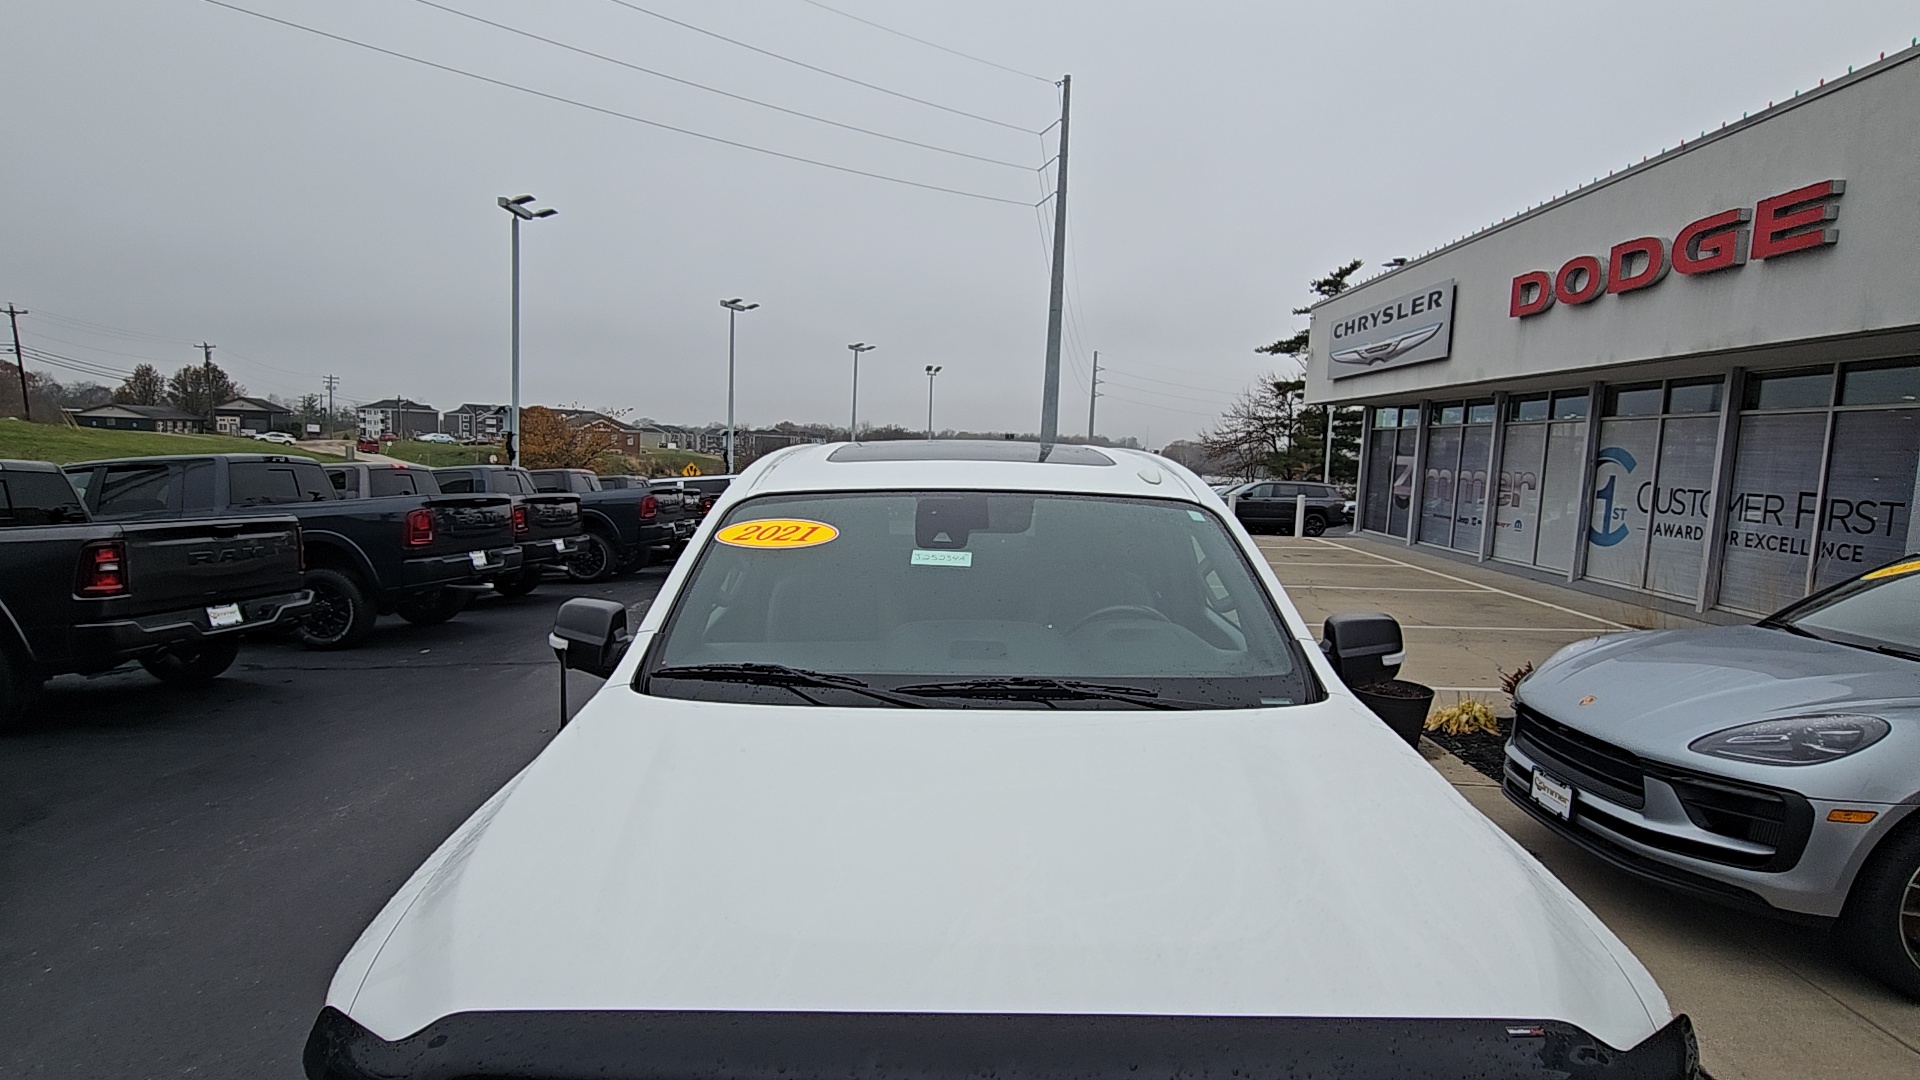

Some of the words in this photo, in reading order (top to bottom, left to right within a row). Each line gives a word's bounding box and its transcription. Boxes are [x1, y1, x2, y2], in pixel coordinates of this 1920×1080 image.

[1509, 179, 1846, 319] DODGE
[1333, 290, 1443, 339] CHRYSLER
[1389, 454, 1537, 509] Zmmer
[731, 525, 822, 542] 2021
[1794, 491, 1907, 537] FIRST
[188, 546, 264, 565] RAM
[1653, 522, 1704, 541] AWARD
[1744, 532, 1864, 563] EXCELLNCE
